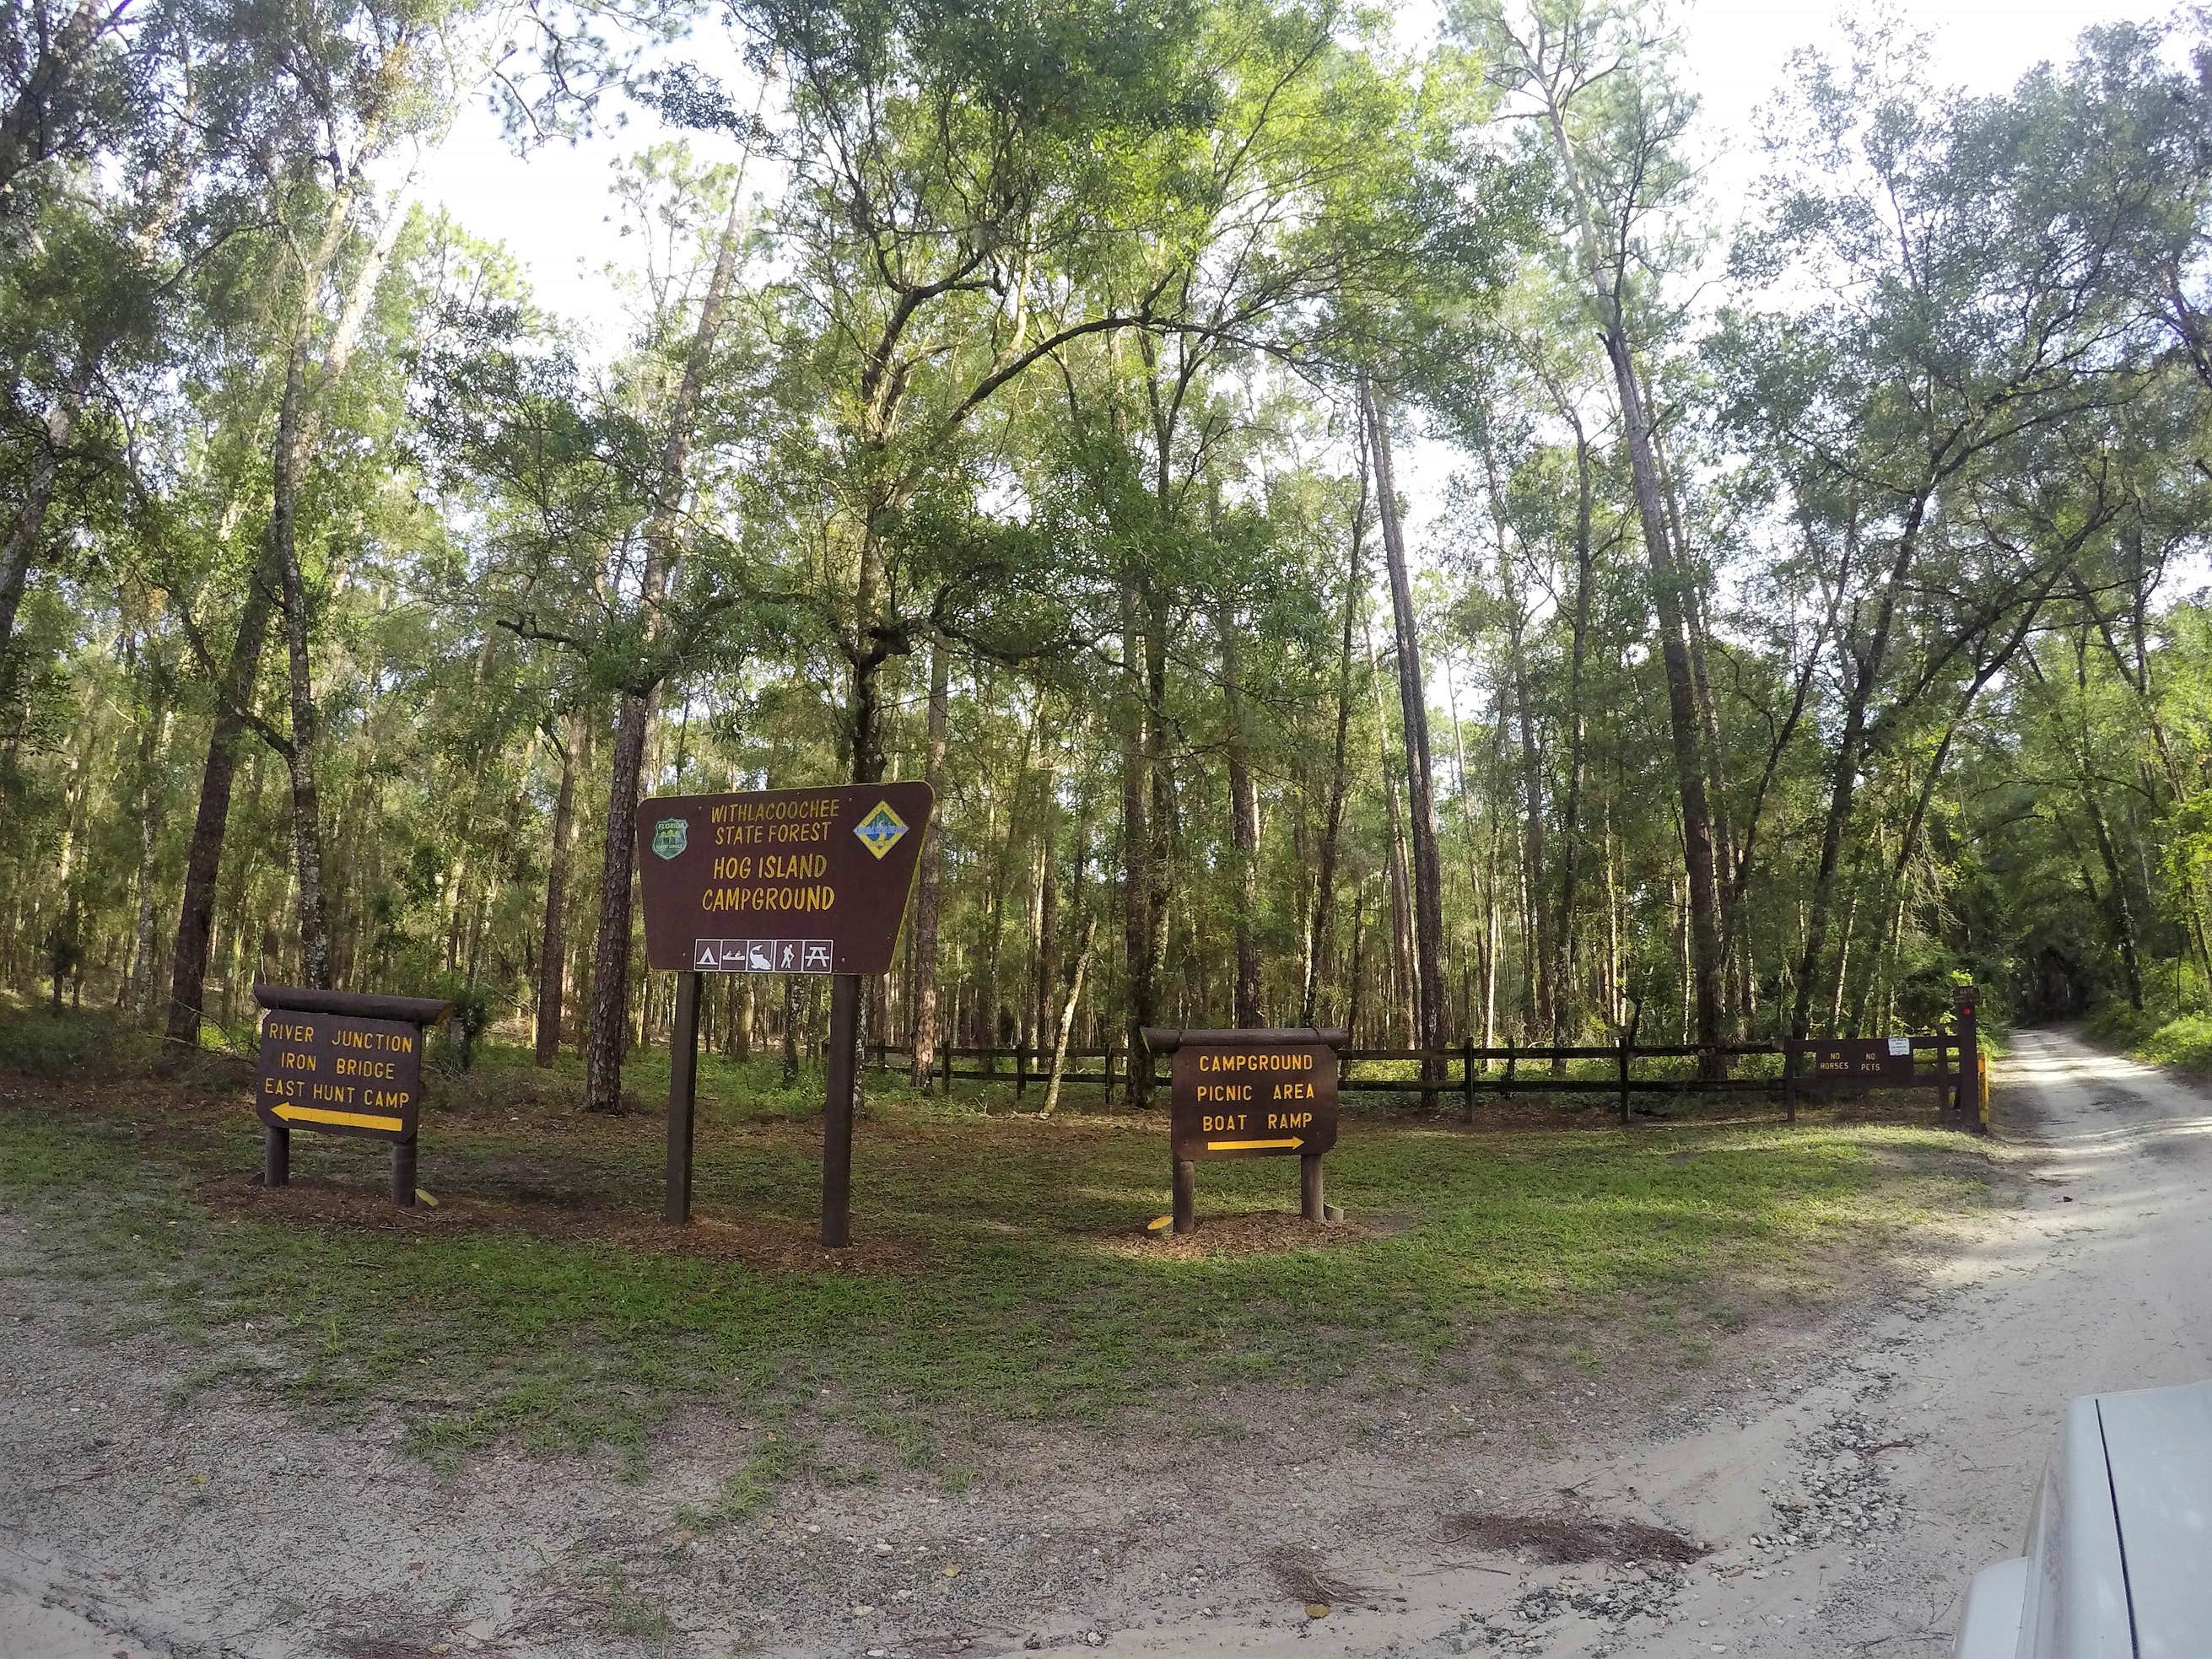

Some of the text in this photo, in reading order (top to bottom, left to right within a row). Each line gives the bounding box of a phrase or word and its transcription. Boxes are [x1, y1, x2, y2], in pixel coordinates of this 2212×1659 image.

[710, 799, 840, 823] WITHLACOOCHEE
[715, 821, 832, 845] STATE FOREST
[714, 853, 828, 880] HOG ISLAND
[702, 885, 834, 912] CAMPGROUND
[269, 1022, 413, 1053] RIVER JUNCTION
[281, 1052, 395, 1080] IRON BRIDGE
[1199, 1054, 1314, 1072] CAMPGROUND
[1860, 1063, 1880, 1071] PETS
[265, 1077, 410, 1108] EAST HUNT CAMP
[1197, 1083, 1314, 1102] PICNIC AREA
[1202, 1112, 1313, 1132] BOAT RAMP
